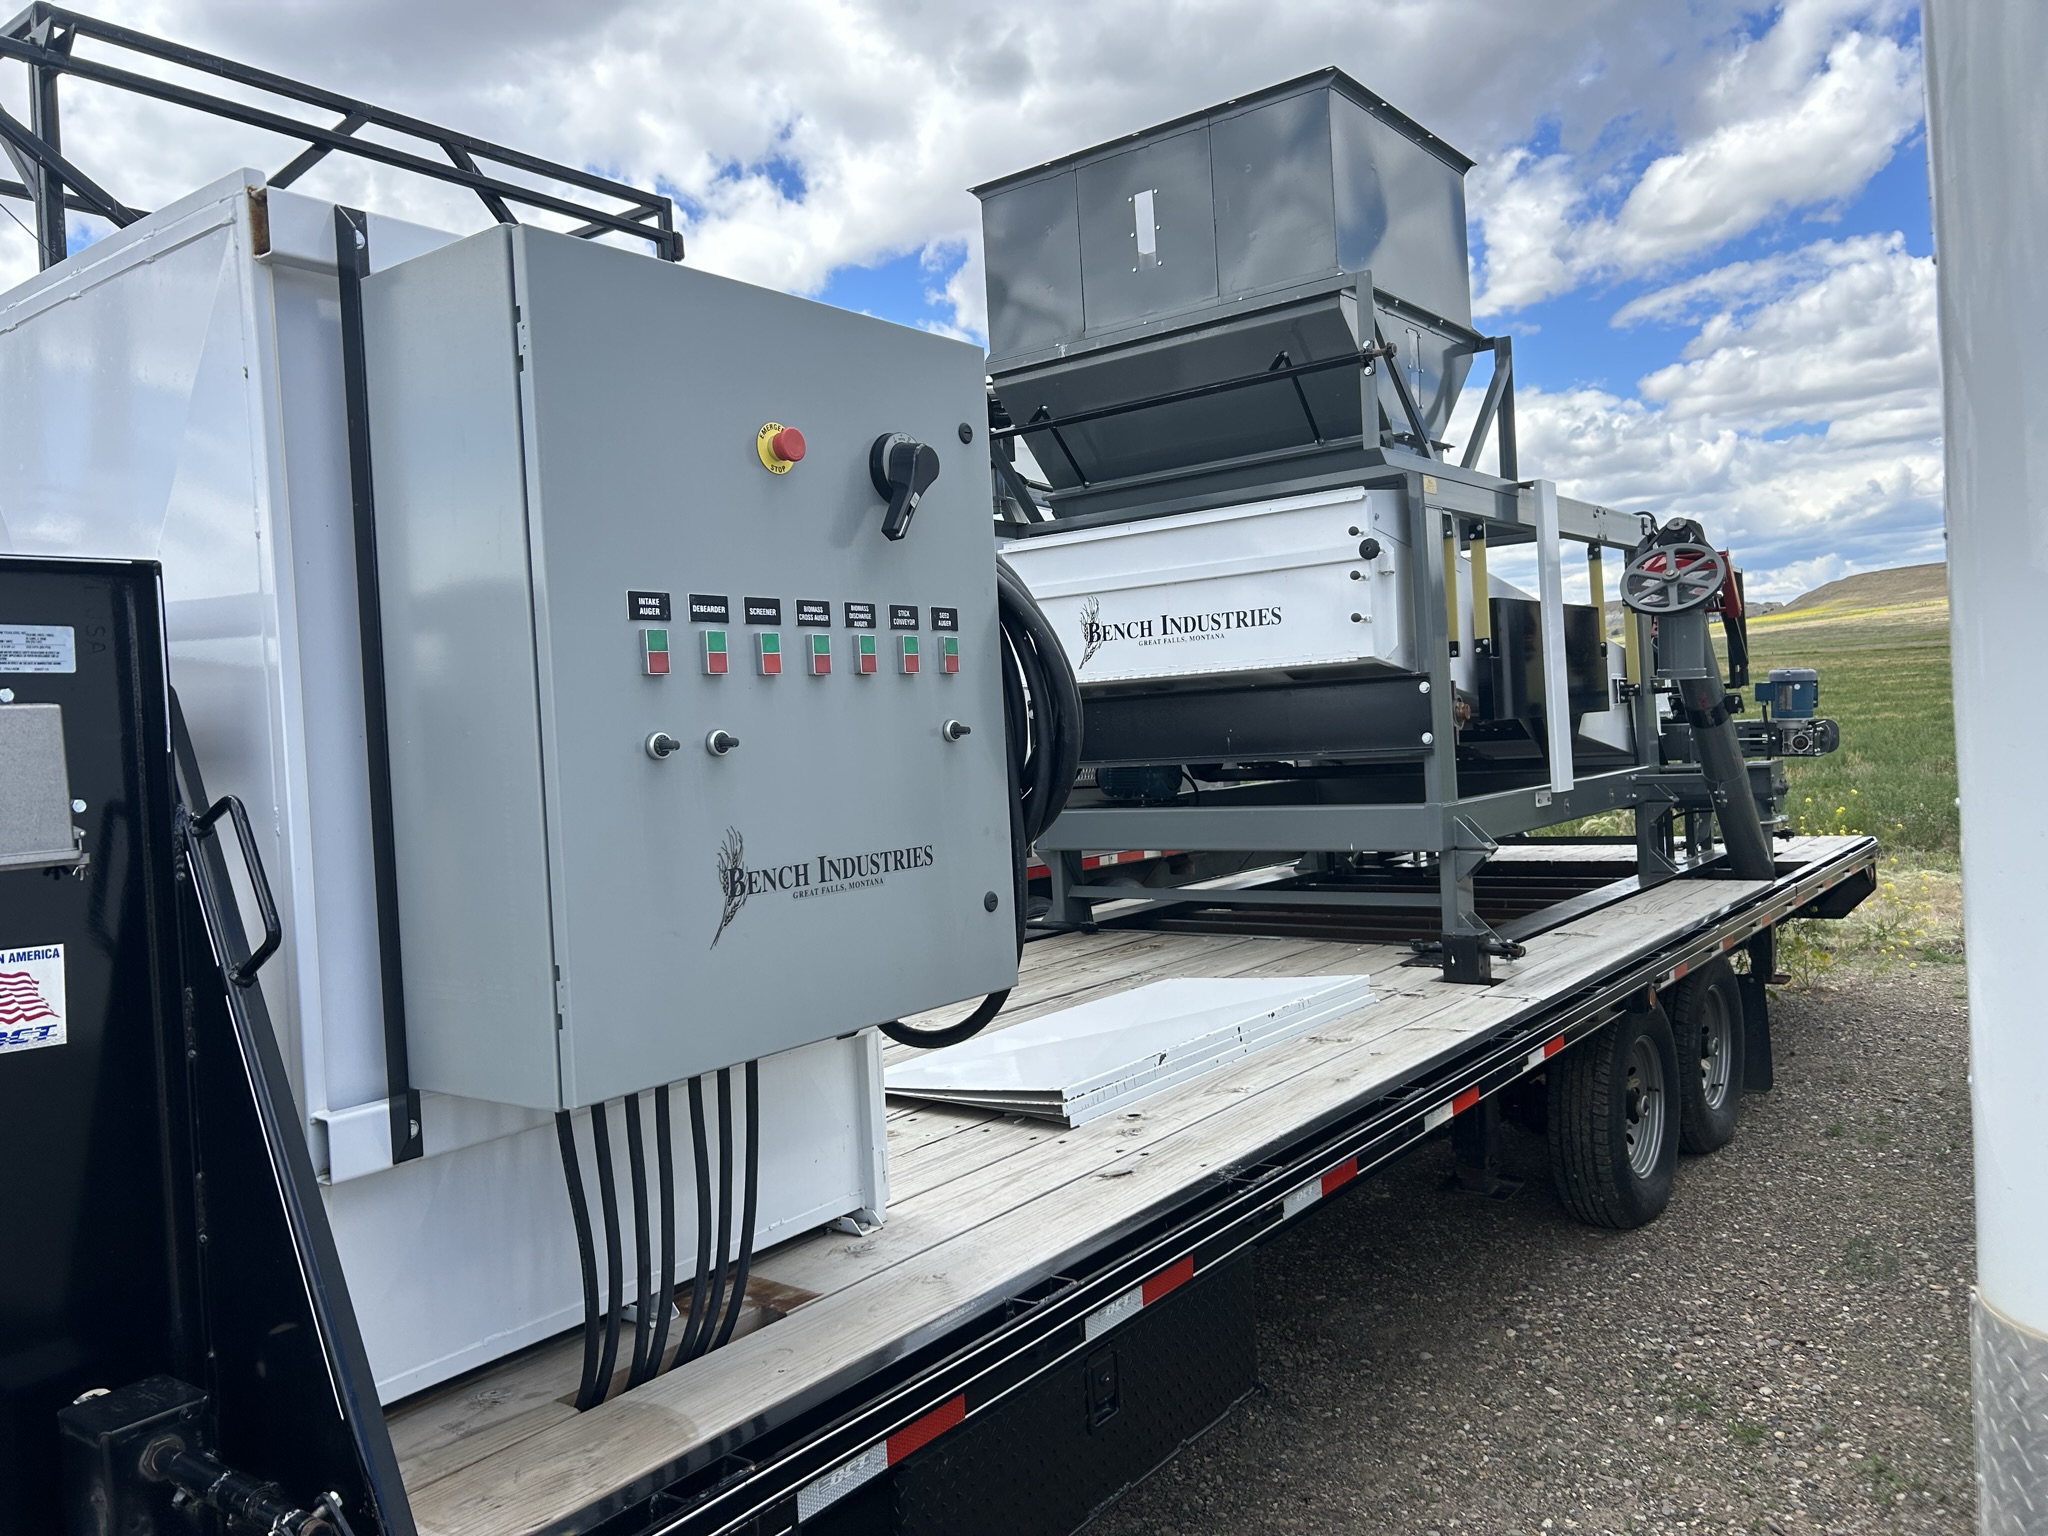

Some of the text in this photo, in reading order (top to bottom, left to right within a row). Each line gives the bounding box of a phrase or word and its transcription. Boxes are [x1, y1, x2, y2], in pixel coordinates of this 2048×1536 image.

[759, 424, 785, 439] EMERGE
[770, 464, 786, 473] STOP
[638, 597, 660, 606] INTAKE
[639, 607, 661, 615] AUGER
[692, 604, 726, 614] DEBEARDER
[749, 607, 777, 616] SCREENER
[798, 613, 829, 622] CROSS AUGER
[893, 617, 916, 626] CONVEYOR
[853, 620, 869, 628] AUGER
[938, 619, 952, 627] AUGER
[1138, 633, 1225, 647] GREAT FALLS, MONTANA
[792, 877, 885, 899] GREAT FALLS, MONTANA
[8, 947, 60, 964] AMERICA
